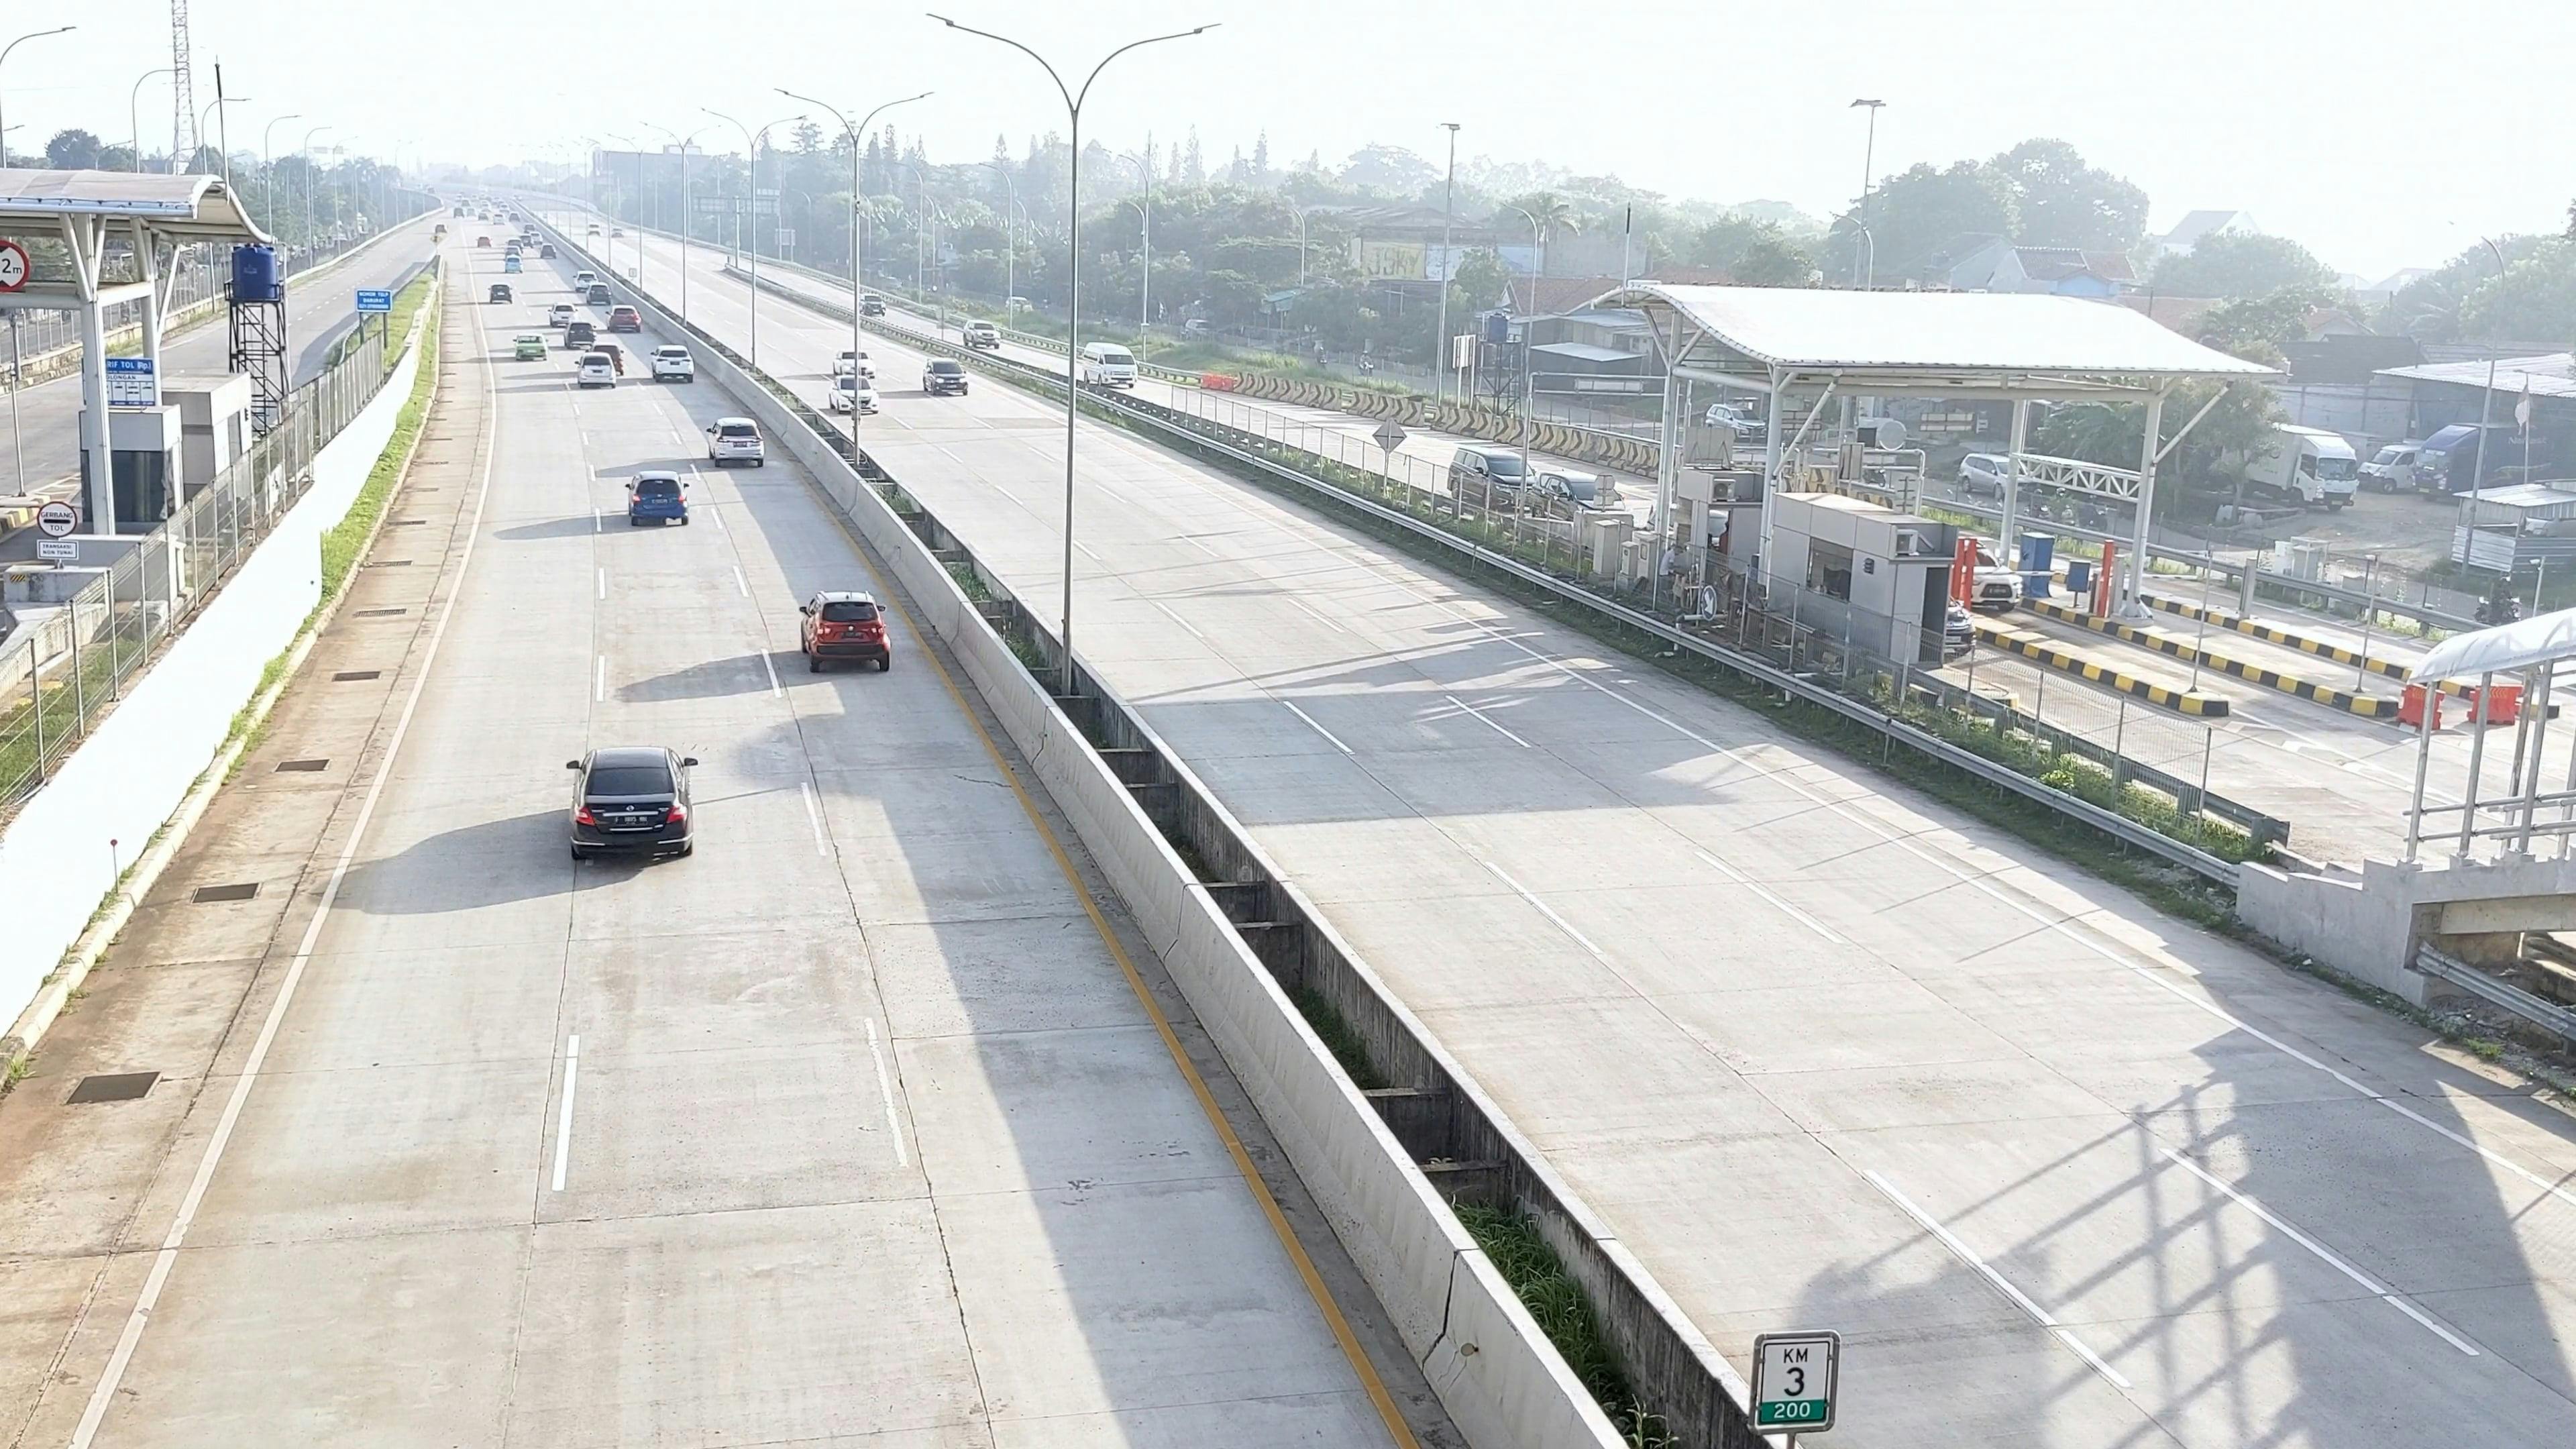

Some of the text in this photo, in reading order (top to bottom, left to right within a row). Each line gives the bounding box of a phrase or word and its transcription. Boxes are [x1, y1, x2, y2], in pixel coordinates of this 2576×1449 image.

[1784, 1348, 1808, 1363] KM
[1784, 1366, 1805, 1397] 3
[1774, 1402, 1811, 1419] 200
